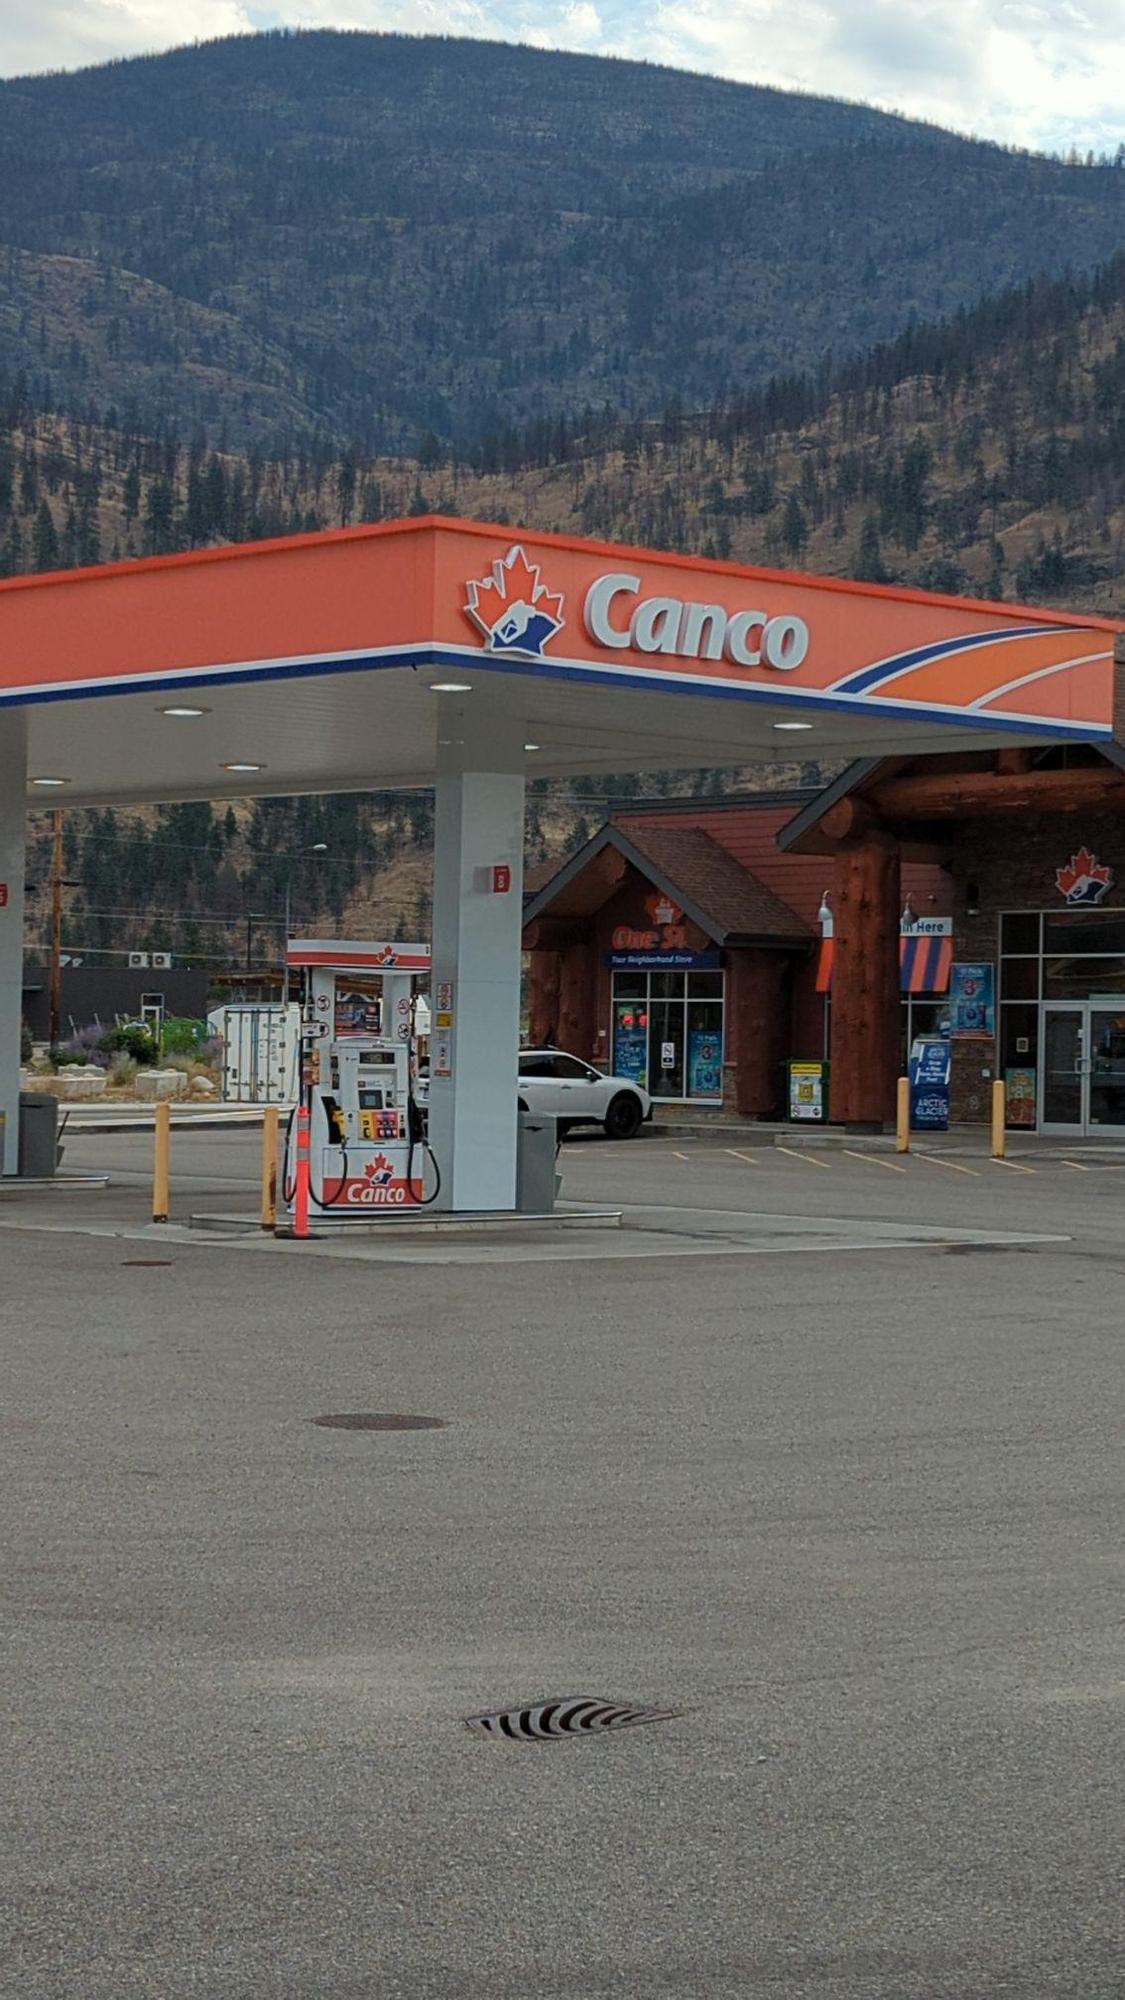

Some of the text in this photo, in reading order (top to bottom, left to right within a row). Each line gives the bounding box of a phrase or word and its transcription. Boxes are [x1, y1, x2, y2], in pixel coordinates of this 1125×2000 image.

[583, 573, 809, 671] Canco
[917, 921, 944, 933] Here
[612, 926, 659, 951] One
[918, 1098, 947, 1107] ARCTIC
[915, 1106, 948, 1116] GLACIER
[347, 1183, 405, 1203] Canco
